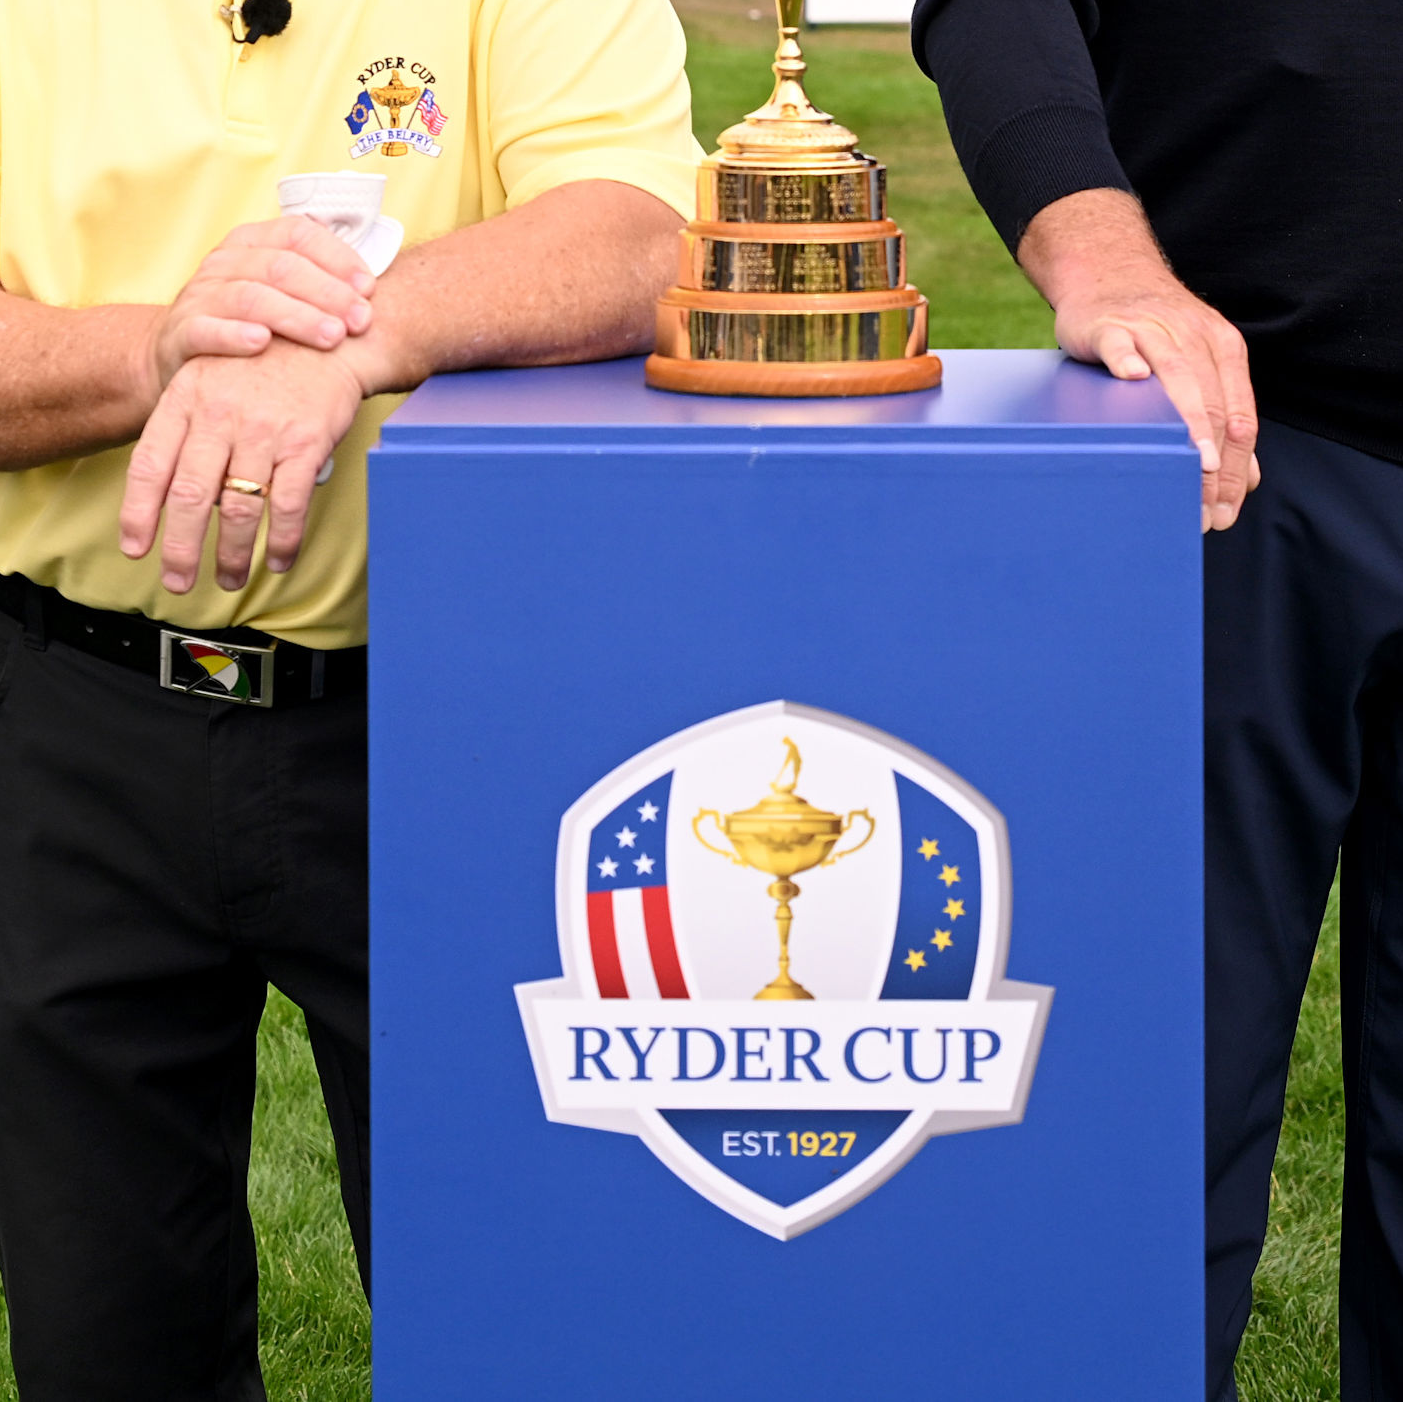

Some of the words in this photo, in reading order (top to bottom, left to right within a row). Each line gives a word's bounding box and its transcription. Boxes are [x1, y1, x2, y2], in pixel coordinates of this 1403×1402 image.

[357, 56, 405, 85] RYDER
[410, 62, 436, 85] CUP
[358, 132, 382, 149] THE
[388, 130, 432, 147] BELFRY
[566, 1026, 830, 1081] RYDER
[843, 1026, 1002, 1083] CUP
[722, 1131, 781, 1157] EST.
[786, 1131, 857, 1157] 1927
